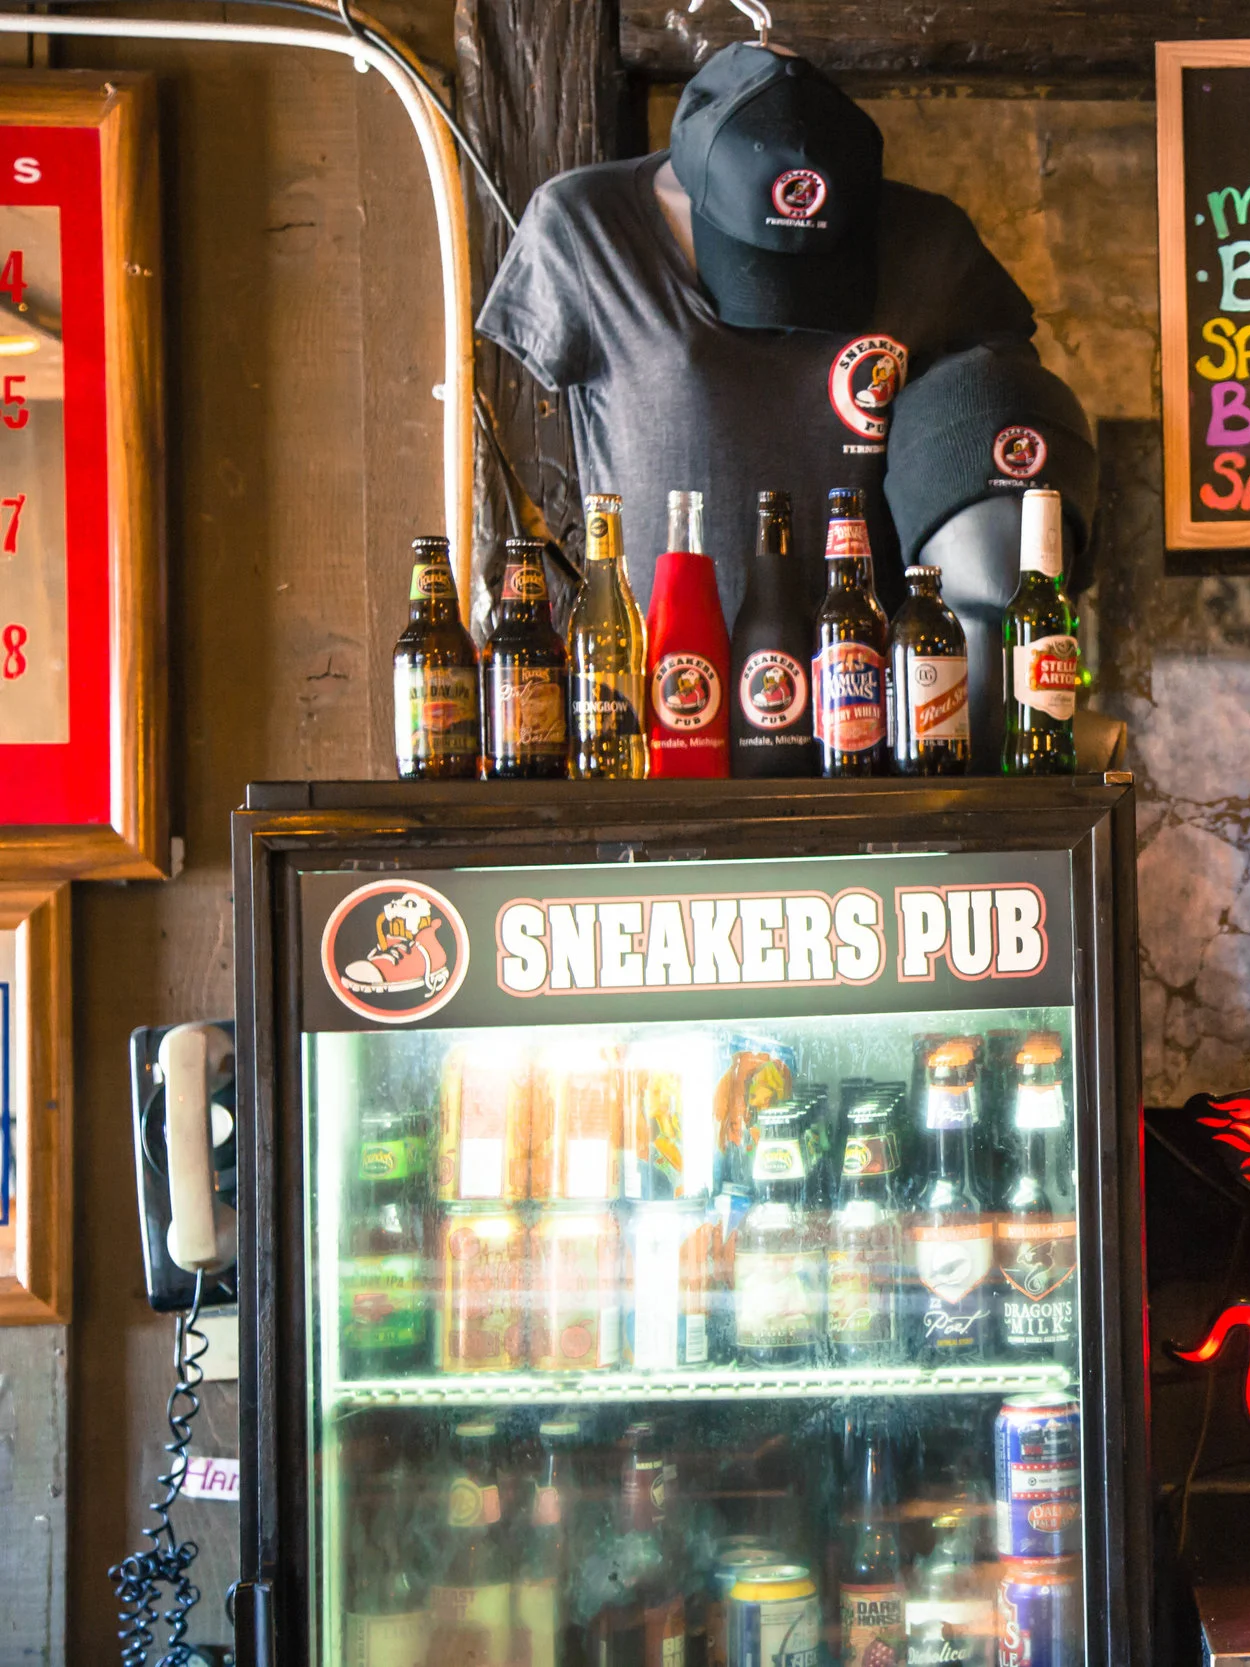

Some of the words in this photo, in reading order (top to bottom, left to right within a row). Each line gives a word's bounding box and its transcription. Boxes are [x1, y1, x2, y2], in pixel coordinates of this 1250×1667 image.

[0, 251, 27, 303] 4
[3, 376, 29, 429] 5
[3, 494, 27, 554] 7
[2, 625, 27, 679] 8
[499, 888, 885, 996] SNEAKERS
[896, 882, 1047, 982] PUB
[1010, 1317, 1067, 1335] MILK
